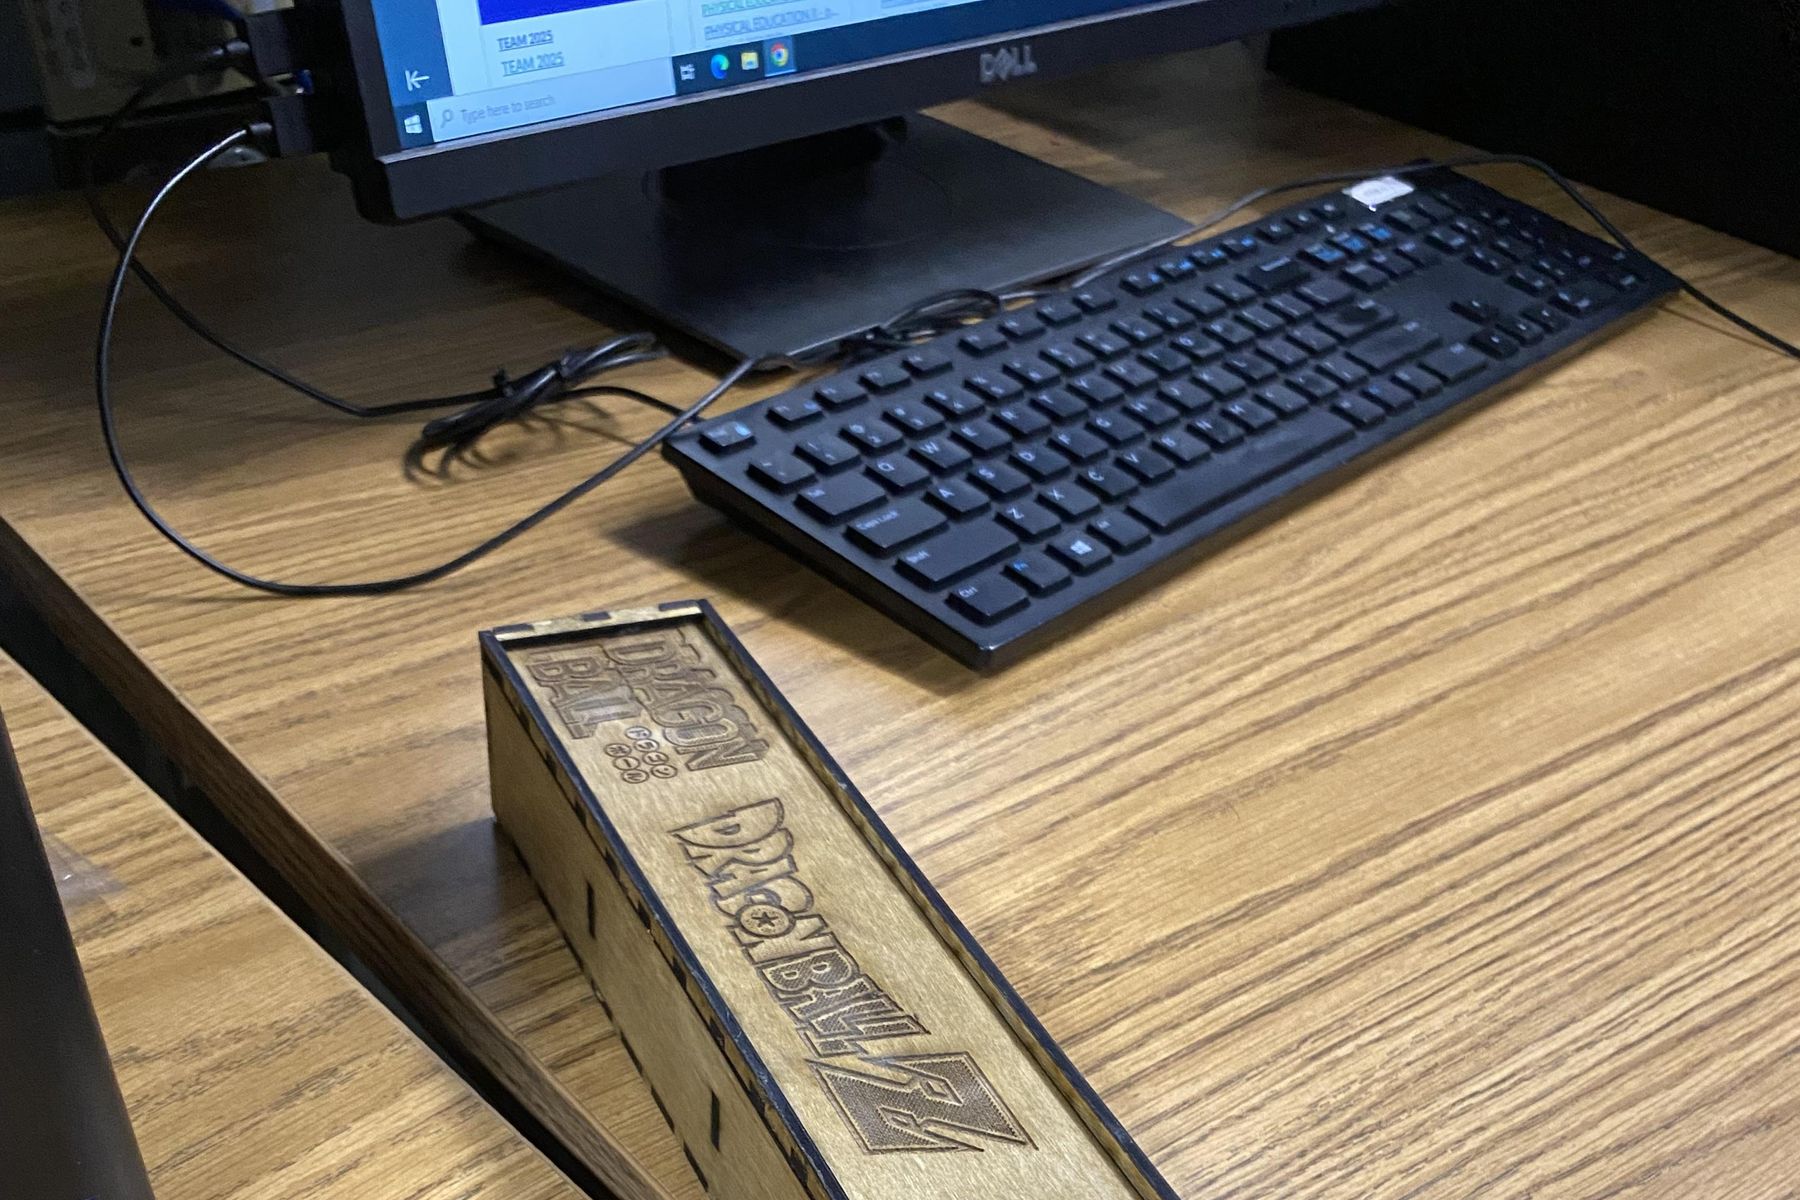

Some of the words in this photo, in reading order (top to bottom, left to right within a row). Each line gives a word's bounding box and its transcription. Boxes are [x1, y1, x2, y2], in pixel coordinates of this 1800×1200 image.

[497, 34, 527, 51] TEAM
[528, 30, 553, 46] 2025
[704, 19, 752, 40] PHYSICAL
[753, 8, 809, 30] EDUCATION
[501, 56, 534, 76] TEAM
[536, 52, 564, 70] 2025
[979, 45, 1038, 82] DELL
[461, 108, 486, 124] Type
[486, 104, 510, 116] here
[511, 102, 522, 113] to
[524, 95, 556, 111] search
[526, 650, 645, 740] BALL
[604, 632, 770, 772] DRAGON
[668, 798, 832, 966] DRAGON
[758, 945, 931, 1058] BALL
[805, 1051, 1039, 1155] Z
